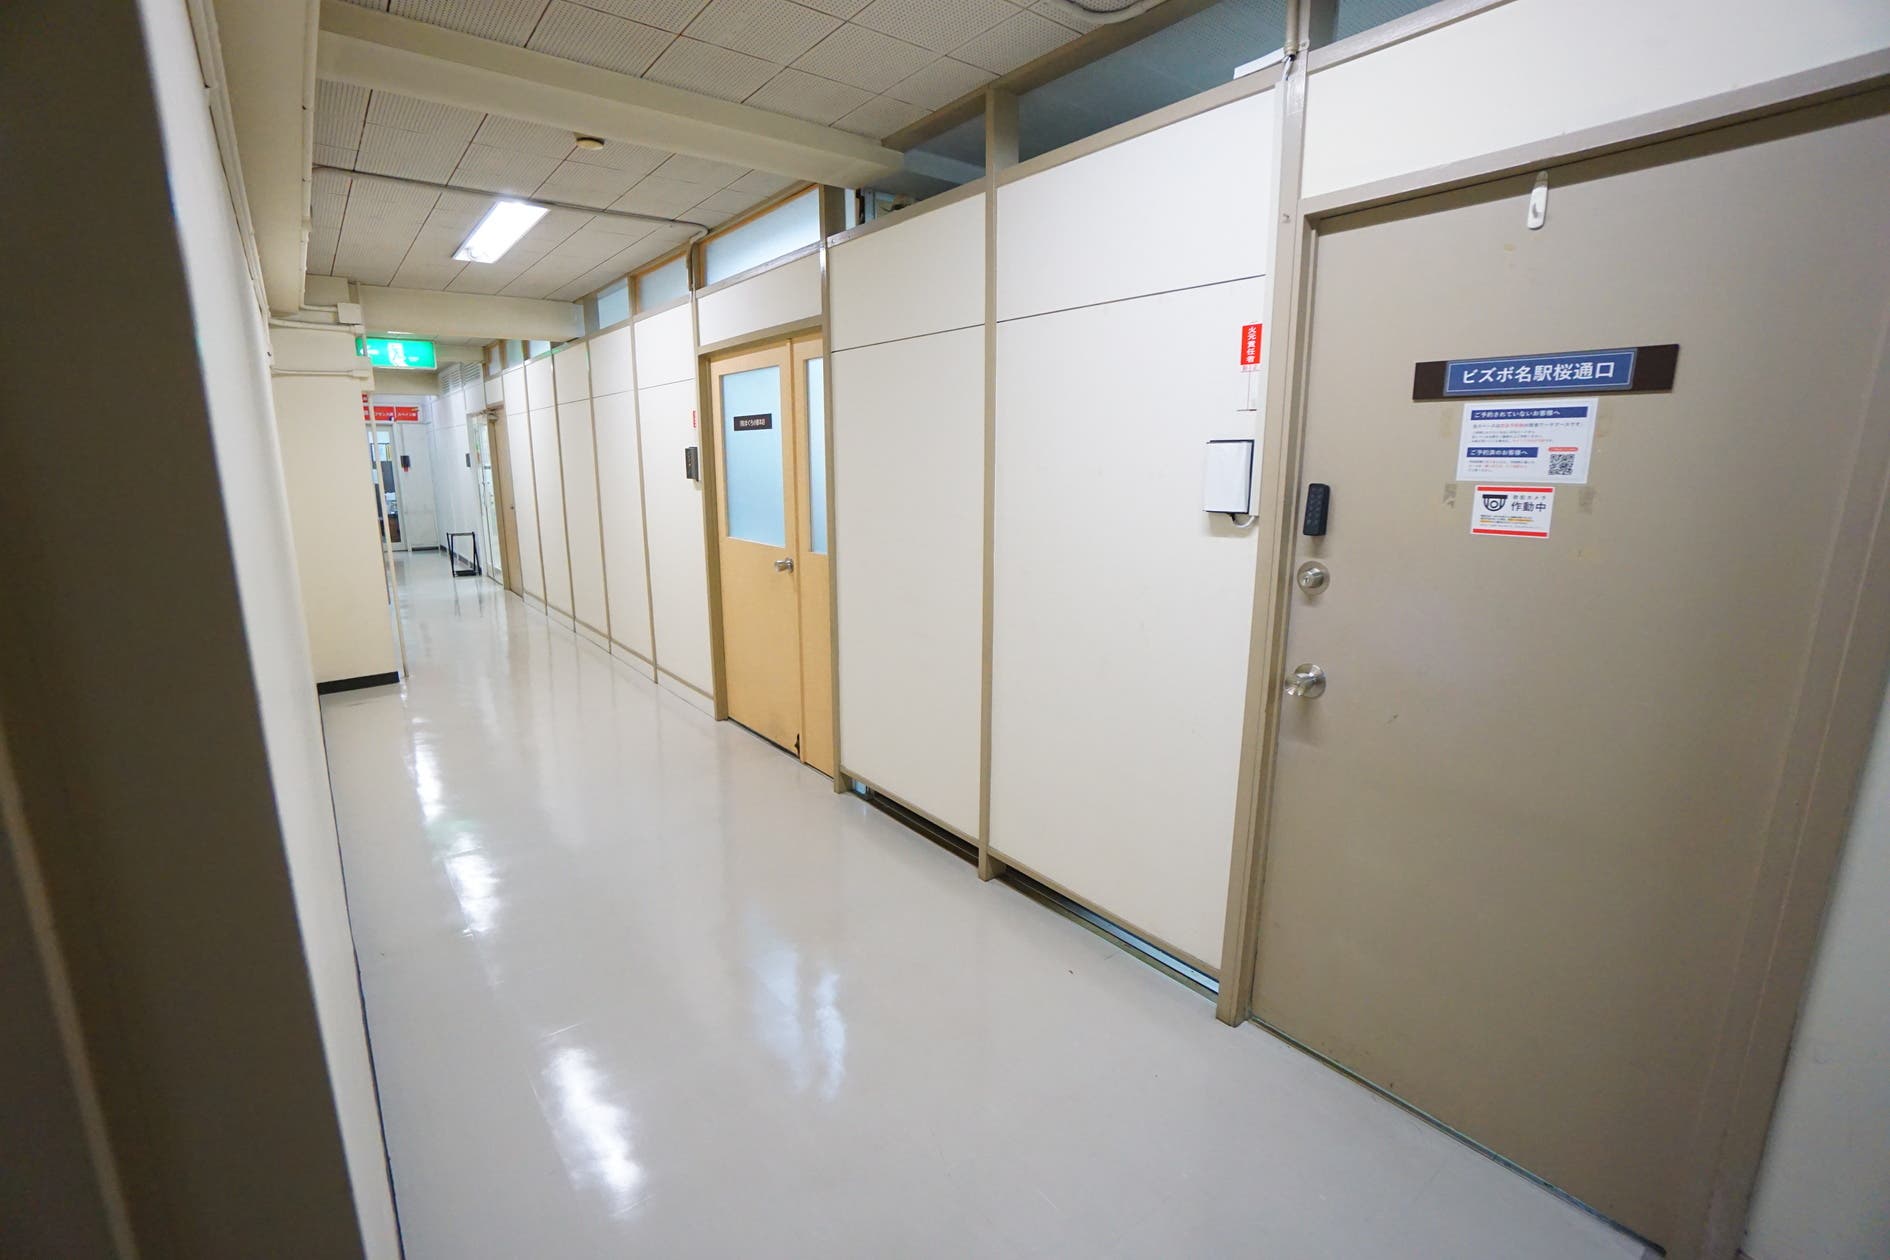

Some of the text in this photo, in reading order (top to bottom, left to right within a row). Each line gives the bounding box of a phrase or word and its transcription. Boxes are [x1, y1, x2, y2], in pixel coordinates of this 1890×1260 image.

[1246, 326, 1257, 363] 火元責任者
[1511, 501, 1546, 512] 作動中
